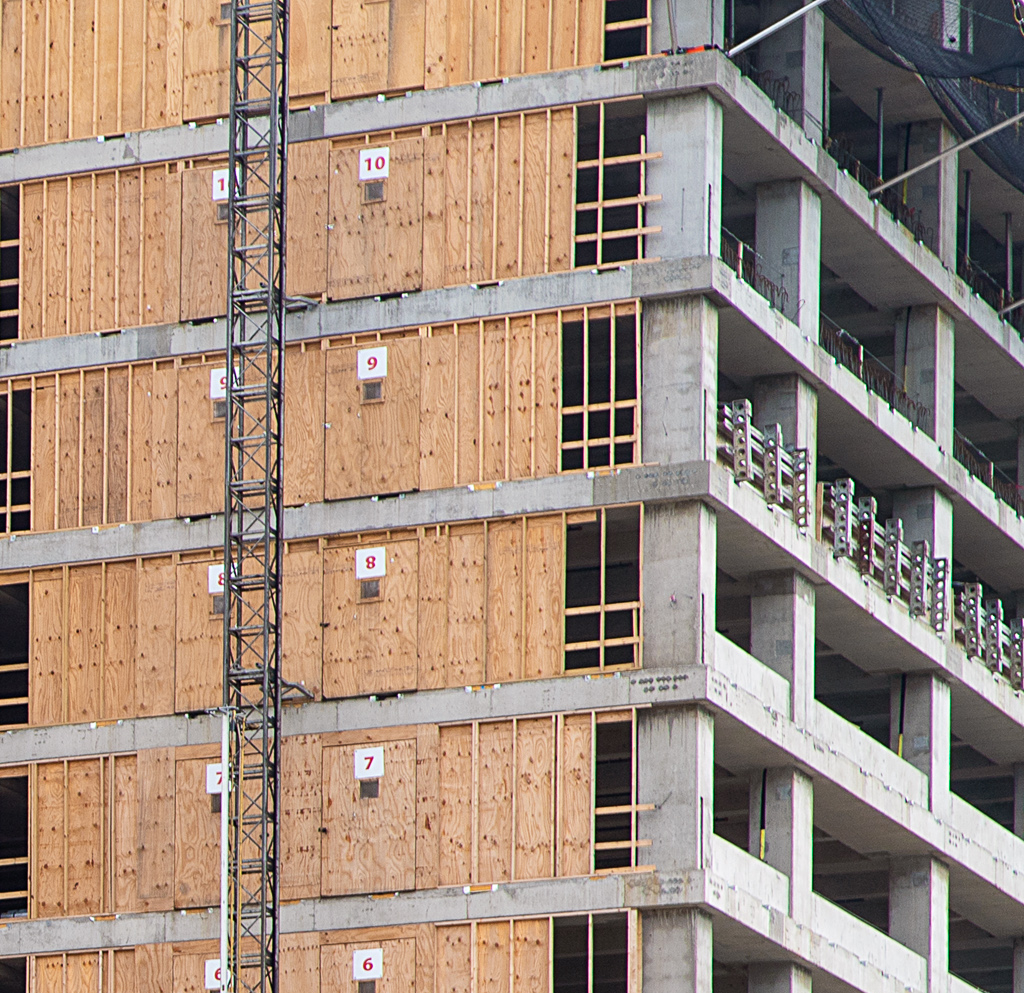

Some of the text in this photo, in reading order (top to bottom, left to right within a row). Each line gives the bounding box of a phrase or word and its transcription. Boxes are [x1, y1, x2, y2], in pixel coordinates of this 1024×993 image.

[364, 156, 385, 171] 10
[367, 356, 378, 370] 9
[219, 376, 226, 390] 9
[365, 555, 376, 569] 8
[364, 756, 374, 770] 7
[362, 957, 373, 971] 6
